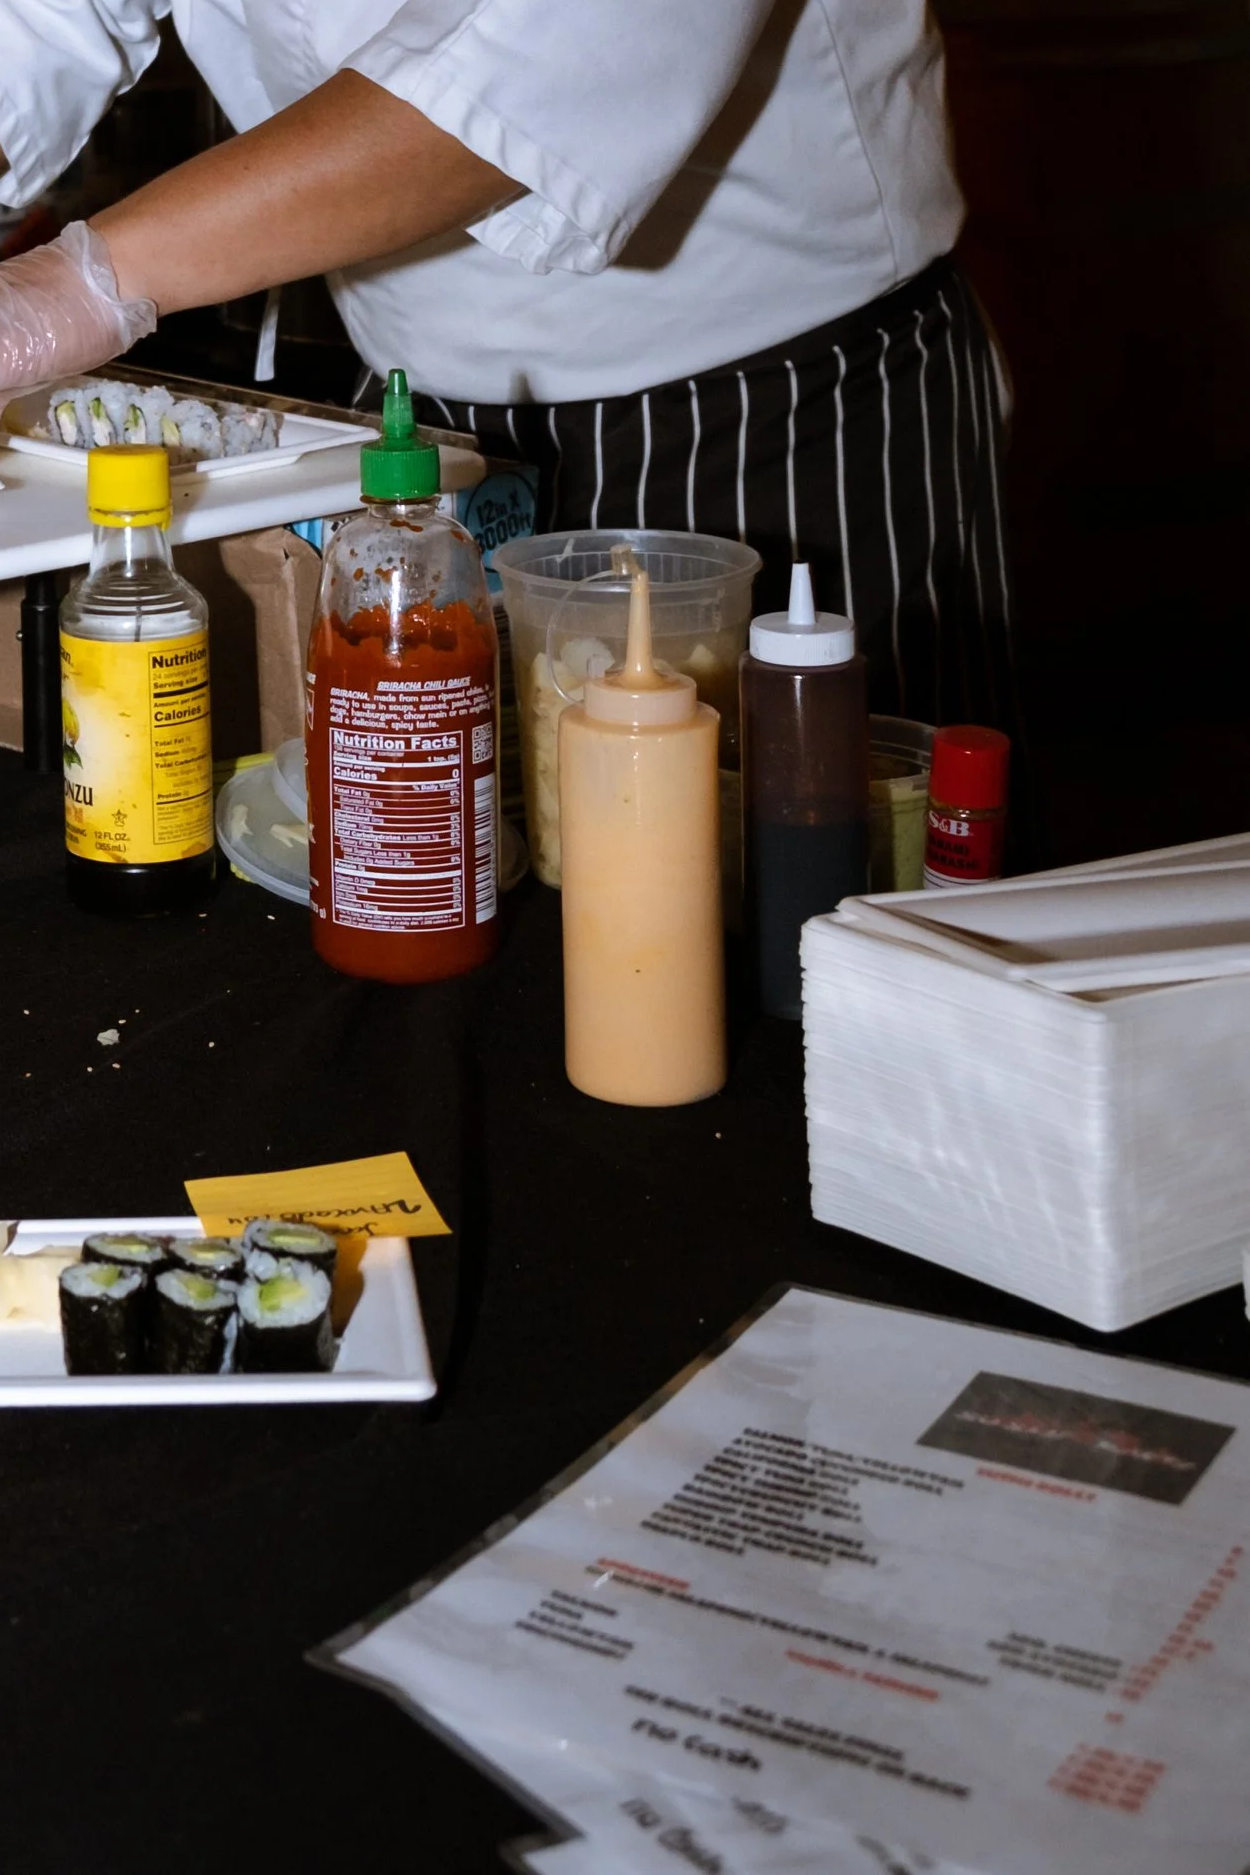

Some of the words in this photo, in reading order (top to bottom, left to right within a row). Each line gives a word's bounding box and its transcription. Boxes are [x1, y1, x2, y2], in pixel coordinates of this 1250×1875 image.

[152, 648, 206, 668] Nutrition
[153, 681, 184, 689] Serving
[377, 681, 421, 690] SRIRACHA
[424, 680, 446, 689] CHILI
[447, 676, 471, 687] SAUCE
[330, 687, 370, 701] SRIRACHA,
[374, 693, 396, 702] made
[399, 693, 418, 702] from
[330, 697, 349, 709] ready
[352, 700, 360, 708] to
[379, 702, 386, 710] in
[419, 703, 449, 711] sauces,
[154, 705, 201, 722] Calories
[351, 708, 401, 721] hamburgers,
[404, 711, 426, 720] chow
[428, 710, 447, 719] mein
[330, 714, 343, 723] add
[351, 717, 388, 729] delicious,
[391, 721, 414, 731] spicy
[416, 720, 439, 729] taste.
[333, 731, 406, 750] Nutrition
[411, 736, 457, 749] Facts
[333, 751, 357, 759] Serving
[334, 766, 377, 780] Calories
[452, 769, 459, 778] 0
[66, 778, 93, 806] NZU
[334, 786, 349, 794] Total
[334, 811, 370, 822] Cholesterol
[929, 810, 970, 837] S&B
[94, 830, 103, 839] 12
[334, 828, 350, 836] Total
